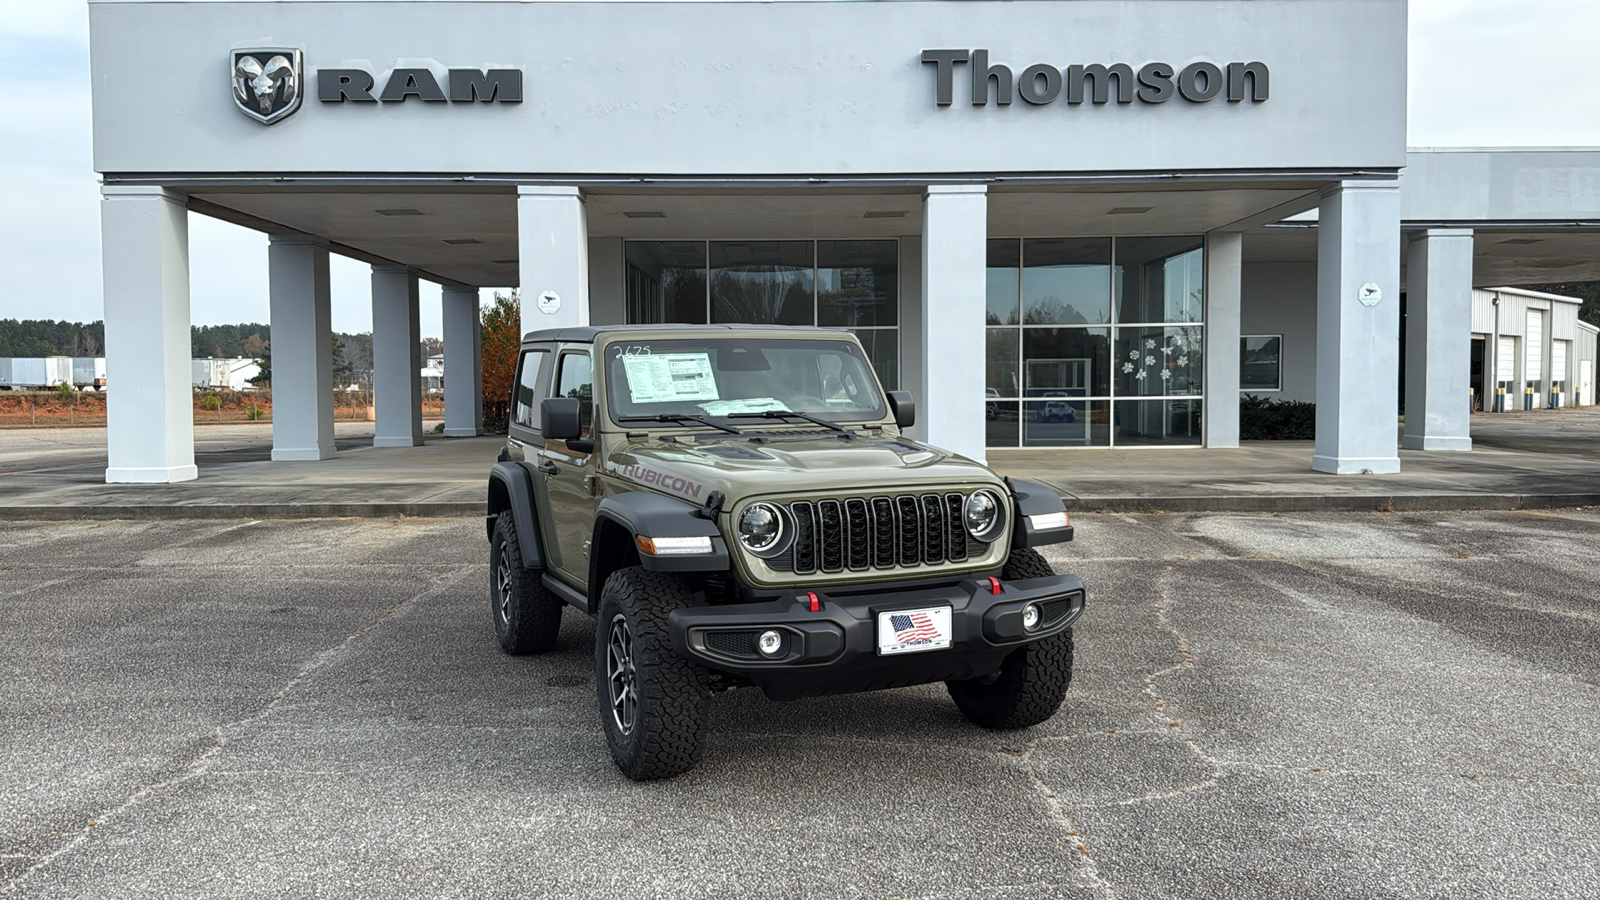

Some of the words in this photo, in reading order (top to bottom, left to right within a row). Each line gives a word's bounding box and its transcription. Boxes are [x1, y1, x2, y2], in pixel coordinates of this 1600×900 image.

[317, 68, 523, 103] RAM
[921, 49, 1270, 106] Thomson
[613, 345, 651, 359] 2675
[623, 464, 702, 498] RUBICON
[906, 639, 933, 647] THOMSON
